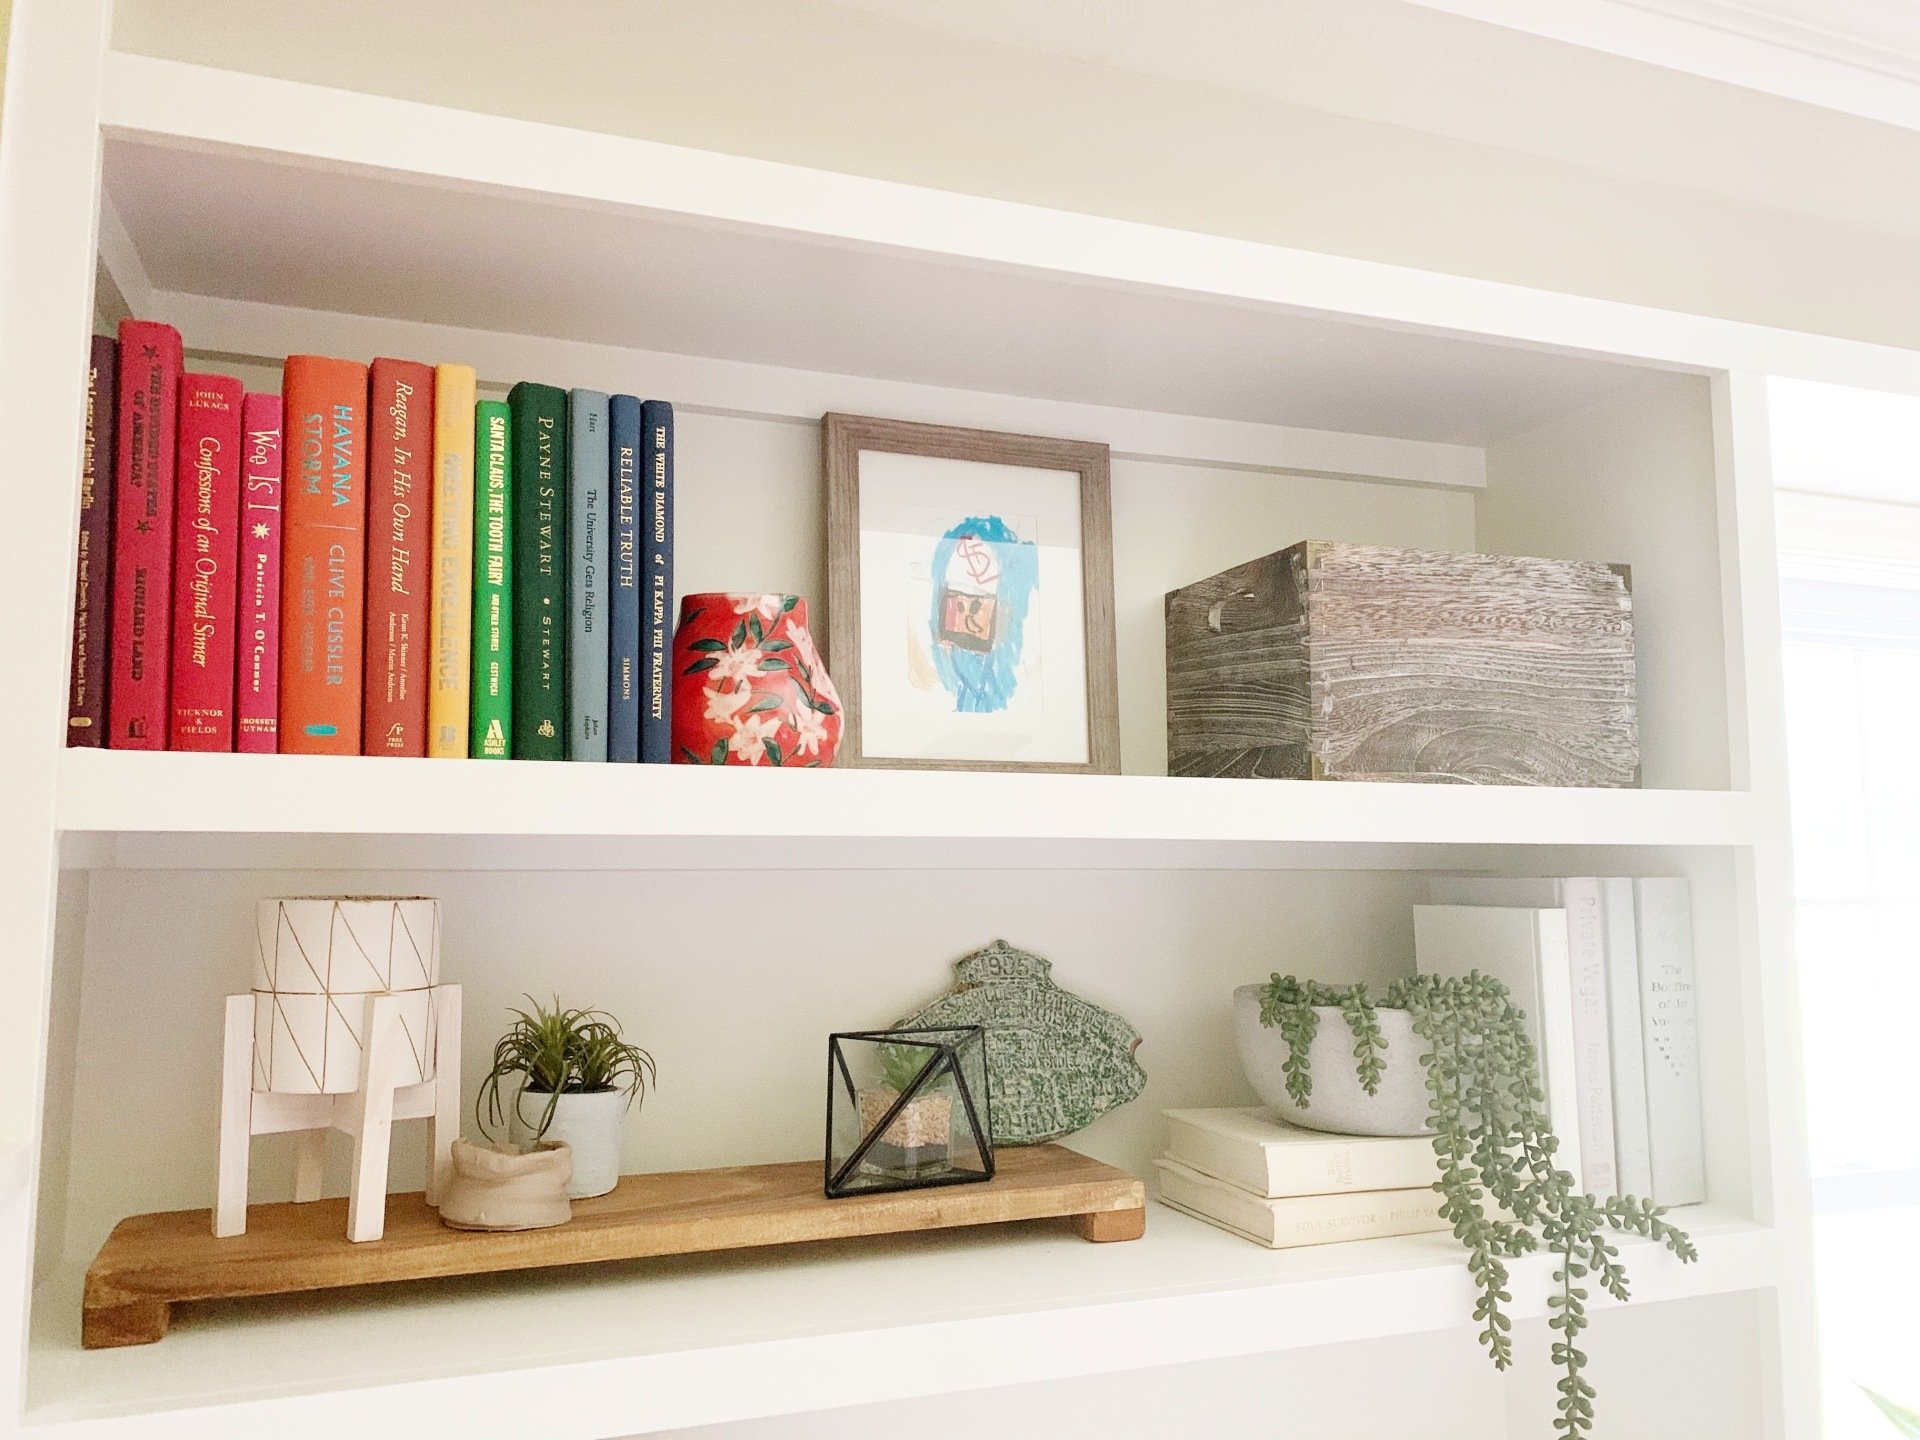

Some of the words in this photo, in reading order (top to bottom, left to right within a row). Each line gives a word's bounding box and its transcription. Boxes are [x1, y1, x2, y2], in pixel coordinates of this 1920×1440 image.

[133, 390, 145, 407] OF
[189, 400, 229, 410] LUKACS
[195, 390, 224, 400] JOHN
[389, 380, 414, 442] Reagan,
[489, 416, 505, 453] SANTA
[588, 412, 598, 433] Hart
[655, 426, 666, 449] THE
[247, 428, 281, 465] Woe
[302, 413, 323, 495] STORM
[331, 404, 354, 508] HAVANA
[393, 446, 412, 465] In
[538, 416, 554, 480] PAYNE
[193, 436, 221, 514] Confessions
[247, 473, 281, 494] Is
[392, 469, 411, 498] His
[487, 453, 504, 492] CLAUS,
[620, 446, 633, 524] RELIABLE
[655, 452, 666, 489] WHITE
[247, 501, 280, 512] I
[441, 453, 462, 550] MEETING
[489, 493, 504, 513] THE
[586, 489, 597, 509] The
[655, 491, 665, 543] DIAMOND
[192, 517, 219, 535] of
[392, 502, 411, 542] Own
[488, 516, 504, 552] TOOTH
[539, 486, 555, 576] STEWART
[582, 512, 597, 563] University
[196, 534, 209, 553] an
[620, 529, 633, 588] TRUTH
[655, 554, 665, 565] of
[190, 557, 217, 619] Original
[255, 554, 267, 606] Patricia
[327, 543, 345, 598] CLIVE
[391, 546, 410, 595] Hand
[487, 556, 503, 587] FAIRY
[585, 565, 596, 589] Gets
[654, 575, 664, 586] PI
[134, 568, 147, 638] RICHARD
[255, 612, 266, 624] T.
[490, 606, 499, 626] OTHER
[582, 591, 596, 634] Religion
[653, 590, 664, 625] KAPPA
[388, 612, 398, 642] Anderson
[400, 613, 409, 632] Kiron
[439, 556, 461, 691] EXCELLENCE
[490, 627, 499, 652] STORIES
[653, 628, 663, 648] PHI
[132, 640, 144, 681] LAND
[190, 621, 215, 669] Sinner
[252, 629, 266, 693] O'Connor
[325, 607, 345, 686] CUSSLER
[388, 648, 397, 671] Martin
[399, 643, 409, 667] Skinner
[542, 616, 552, 690] STEWART
[387, 672, 397, 703] Anderson
[622, 657, 631, 701] SIMMONS
[652, 651, 663, 720] FRATERNITY
[177, 709, 223, 717] TICKNOR
[181, 726, 217, 734] FIELDS
[1579, 896, 1599, 958] Private
[1327, 1214, 1377, 1229] SURVIVOR
